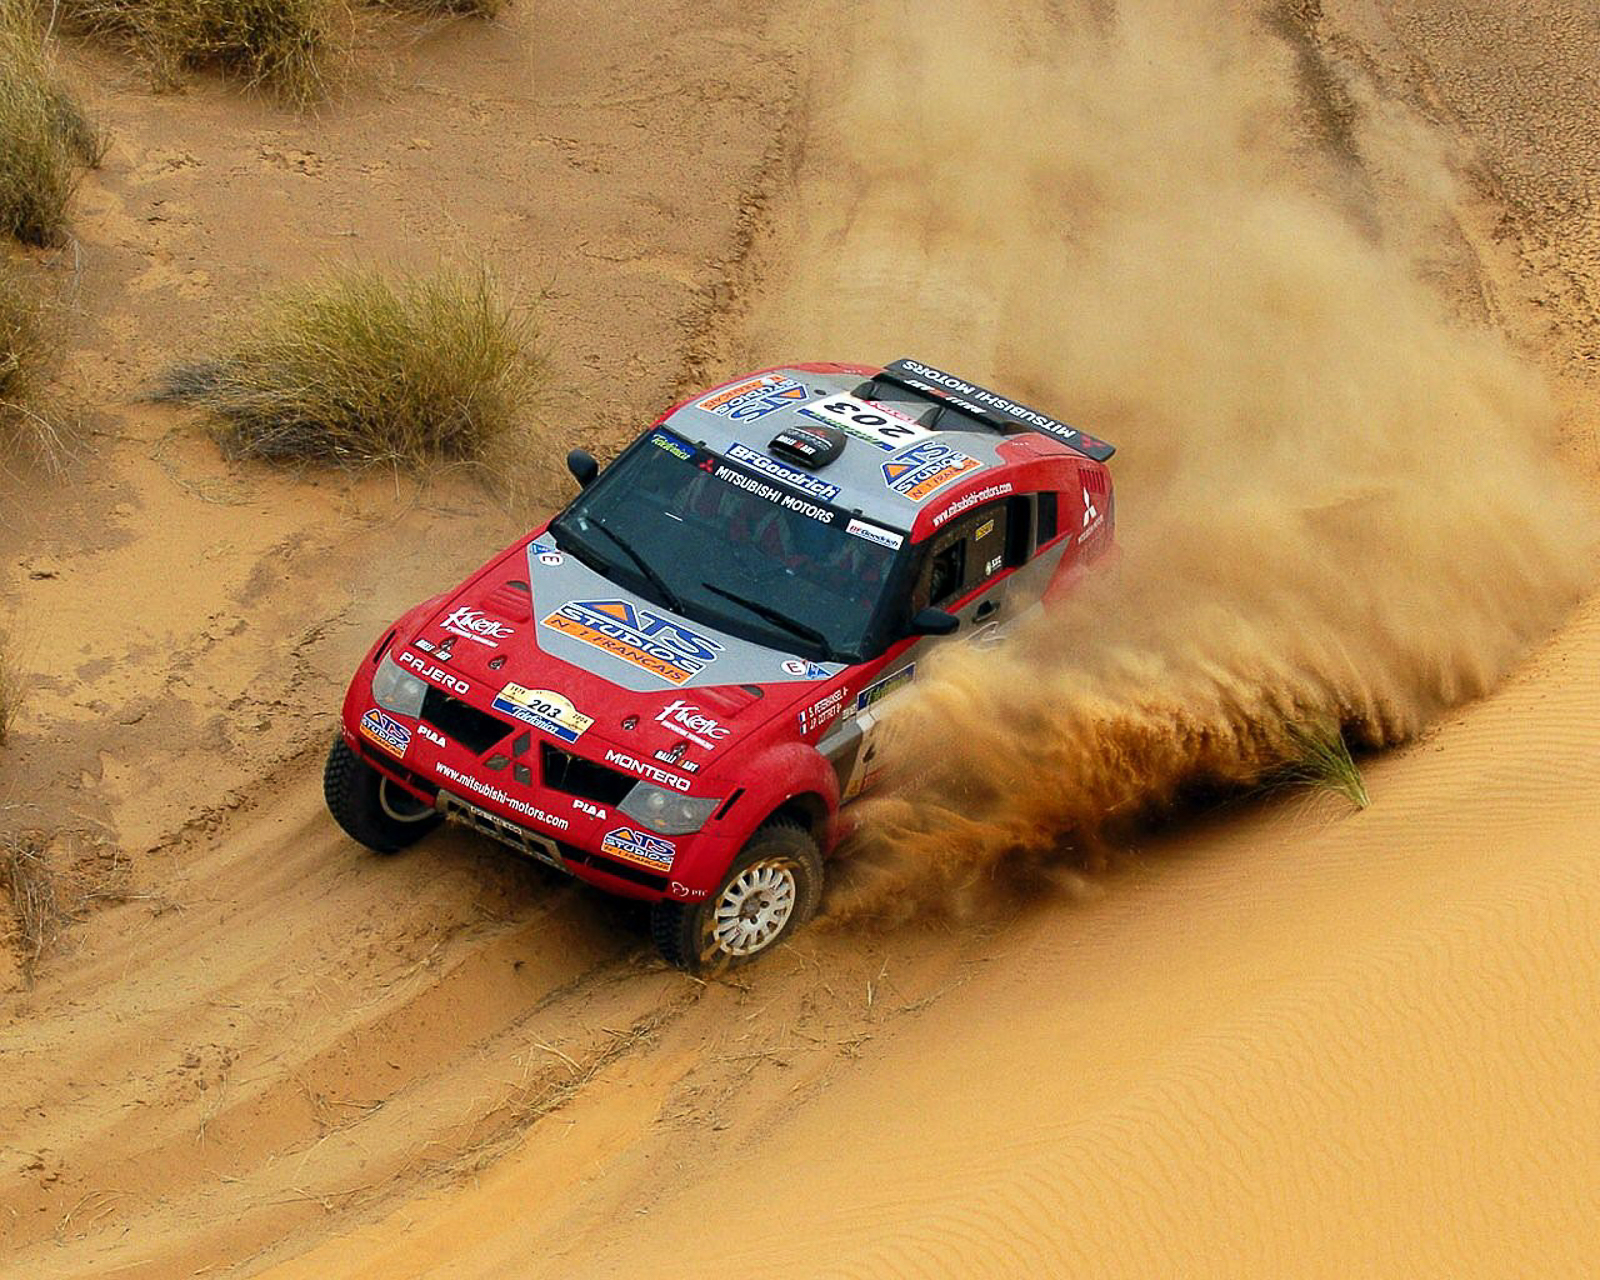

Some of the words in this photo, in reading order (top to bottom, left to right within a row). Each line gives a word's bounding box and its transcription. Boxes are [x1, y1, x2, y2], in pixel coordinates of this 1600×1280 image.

[902, 360, 976, 396] MOTORS
[728, 383, 809, 425] ATS
[823, 402, 915, 438] 203
[974, 390, 1078, 440] MITSUBISHI
[728, 444, 838, 501] BFGoodrich
[880, 441, 951, 487] ATS
[715, 465, 783, 504] MITSUBISHI
[780, 495, 835, 524] MOTORS
[559, 605, 707, 676] STUDIOS
[568, 599, 726, 662] ATS
[400, 652, 470, 695] PAJERO
[363, 708, 412, 744] ATS
[528, 699, 562, 718] 203
[417, 725, 446, 749] PIAA
[604, 750, 692, 792] MONTERO
[435, 761, 570, 831] www.mitsubishi-motors.com
[572, 799, 608, 820] PIAA
[606, 826, 677, 856] ATS
